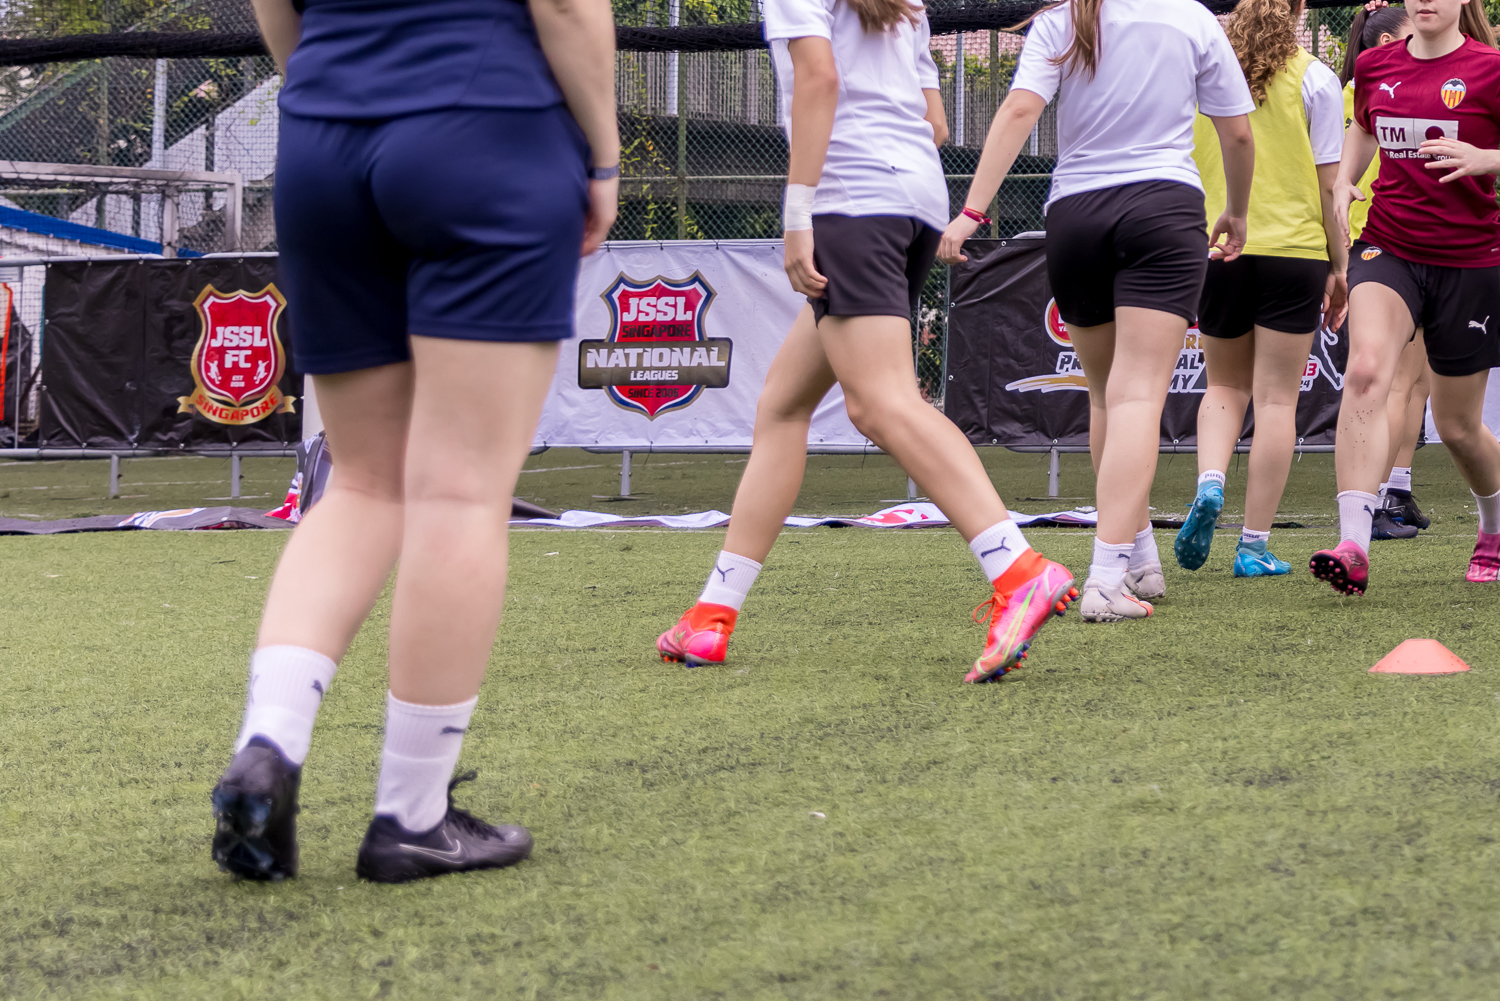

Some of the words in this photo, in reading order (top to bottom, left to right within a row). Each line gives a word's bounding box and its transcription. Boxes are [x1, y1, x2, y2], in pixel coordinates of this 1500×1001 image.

[1380, 126, 1407, 143] TM
[1389, 150, 1407, 159] Real
[622, 296, 693, 322] JSSL
[210, 325, 268, 347] JSSL
[621, 324, 692, 338] SINGAPORE
[224, 350, 252, 368] FC
[586, 347, 726, 369] NATIONAL
[630, 370, 679, 381] LEAGUES
[628, 388, 654, 398] SINCE
[655, 387, 679, 398] 2006
[195, 392, 279, 421] SINGAPORE
